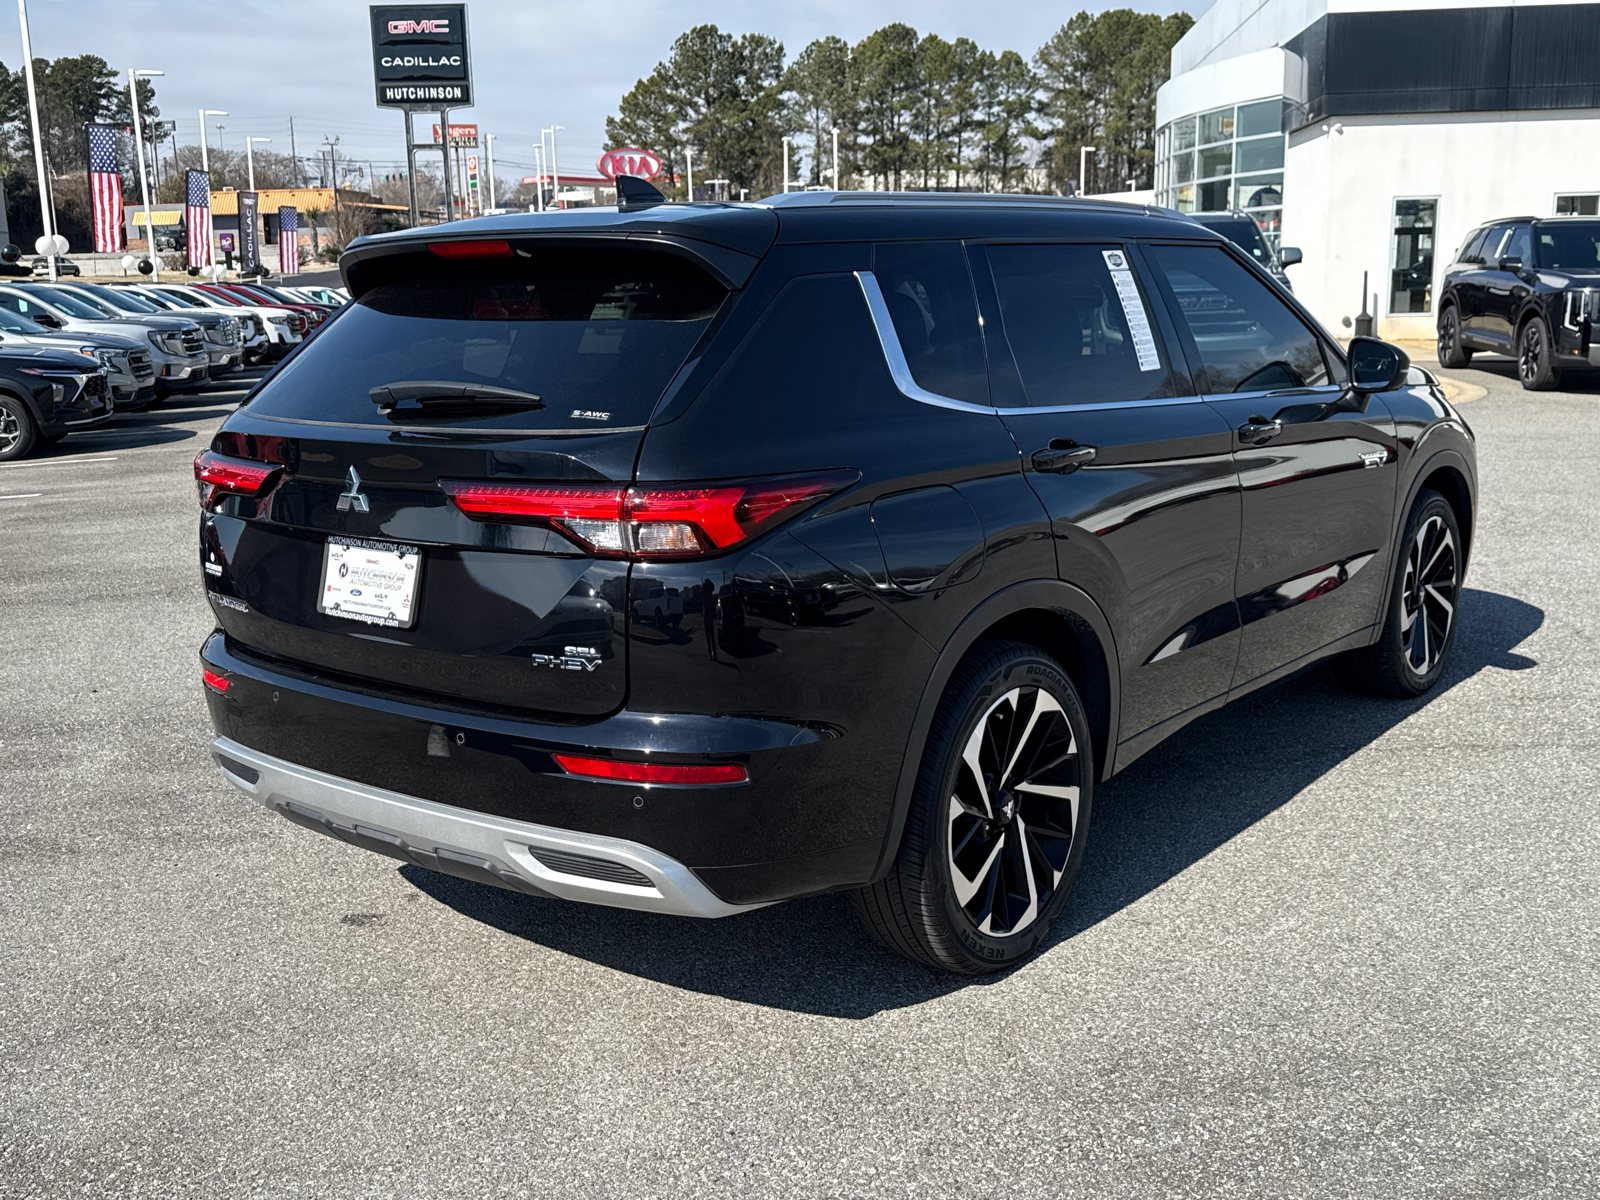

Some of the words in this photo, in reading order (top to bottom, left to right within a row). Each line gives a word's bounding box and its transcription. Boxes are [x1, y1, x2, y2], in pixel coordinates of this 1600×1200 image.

[388, 19, 450, 34] GMC
[381, 56, 461, 67] CADILLAC
[386, 86, 462, 100] HUTCHINSON
[610, 154, 654, 175] KIA
[246, 208, 255, 268] CADILLAC
[572, 409, 611, 418] S-AWC
[328, 535, 361, 547] HUTCHINSON
[362, 540, 398, 552] AUTOMOTIVE
[398, 544, 418, 555] GROUP
[349, 578, 383, 590] AUTOMOTIVE
[383, 582, 402, 592] GROUP
[532, 653, 602, 672] PHEV
[1026, 666, 1068, 694] ROADIAN
[960, 928, 1005, 959] NEXEN
